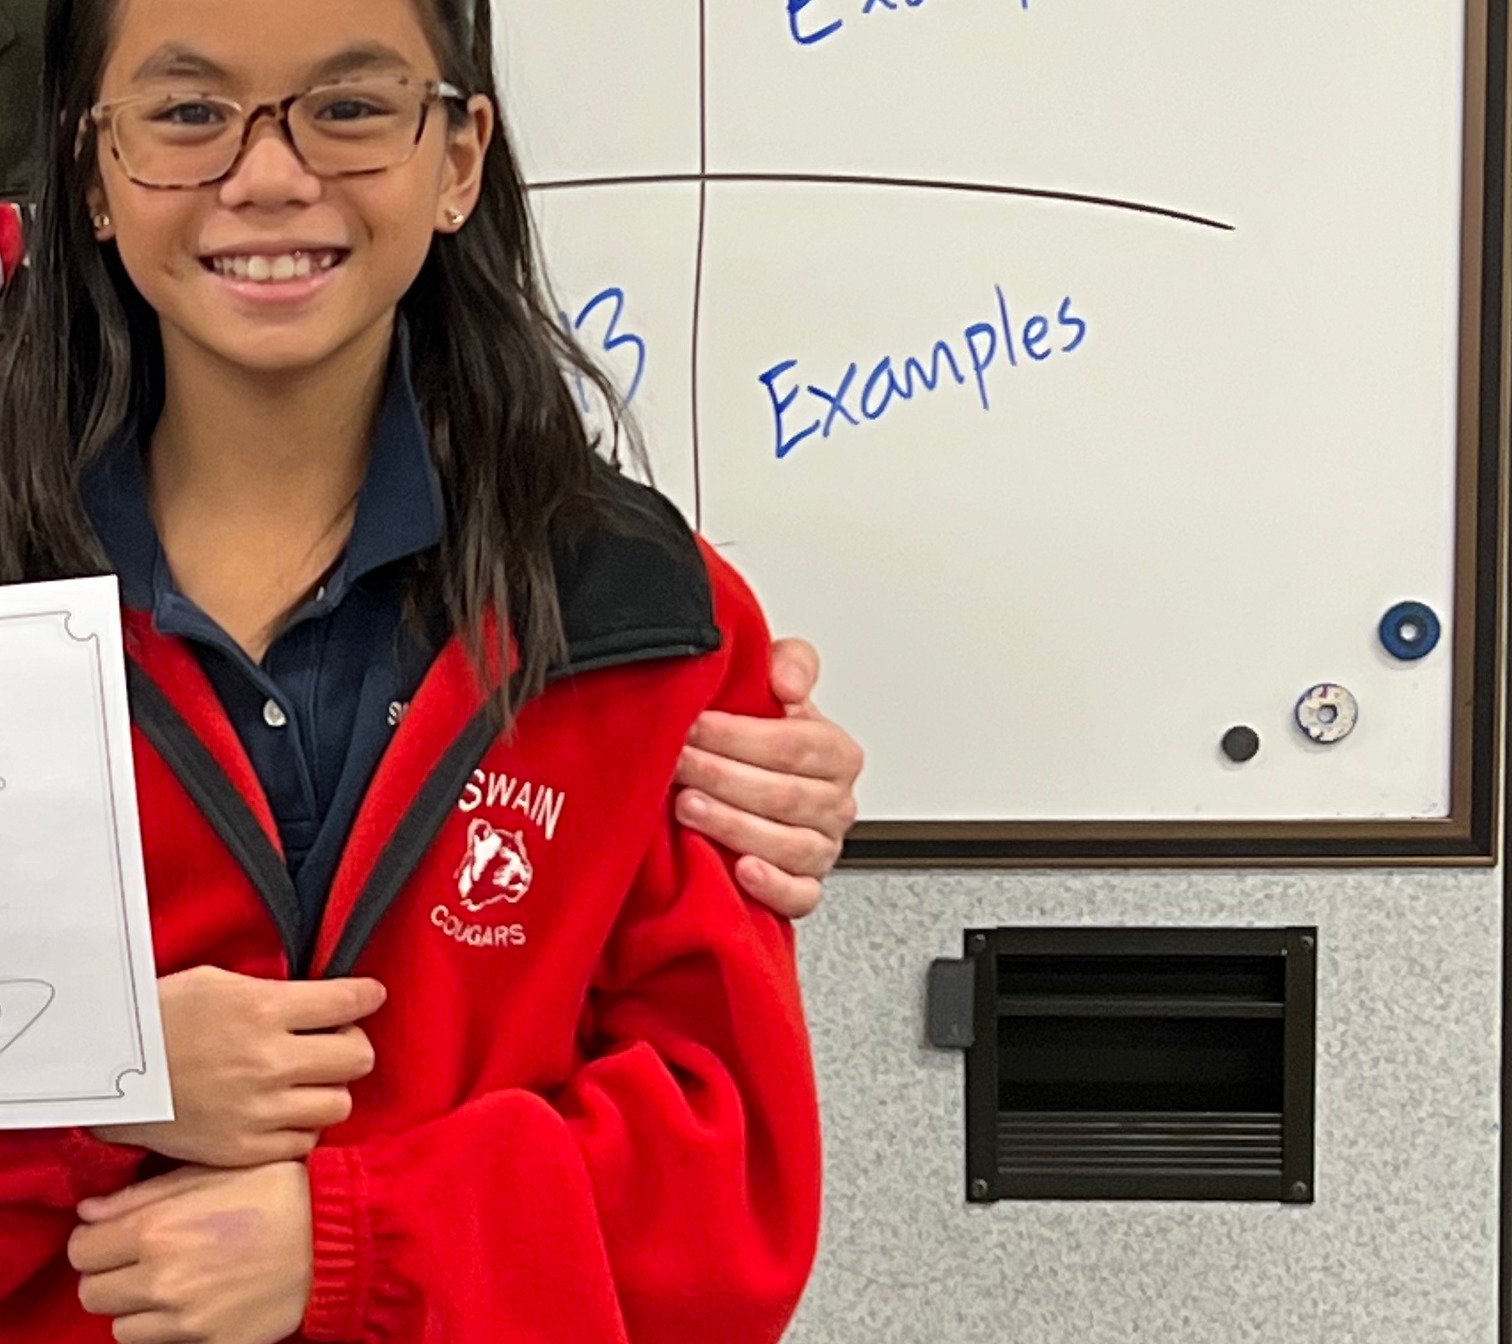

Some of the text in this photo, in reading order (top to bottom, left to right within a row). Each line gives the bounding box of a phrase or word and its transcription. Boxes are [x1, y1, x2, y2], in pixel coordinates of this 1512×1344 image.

[758, 286, 1086, 459] Examples
[458, 768, 565, 841] SWAIN
[430, 905, 526, 947] COUGARS
